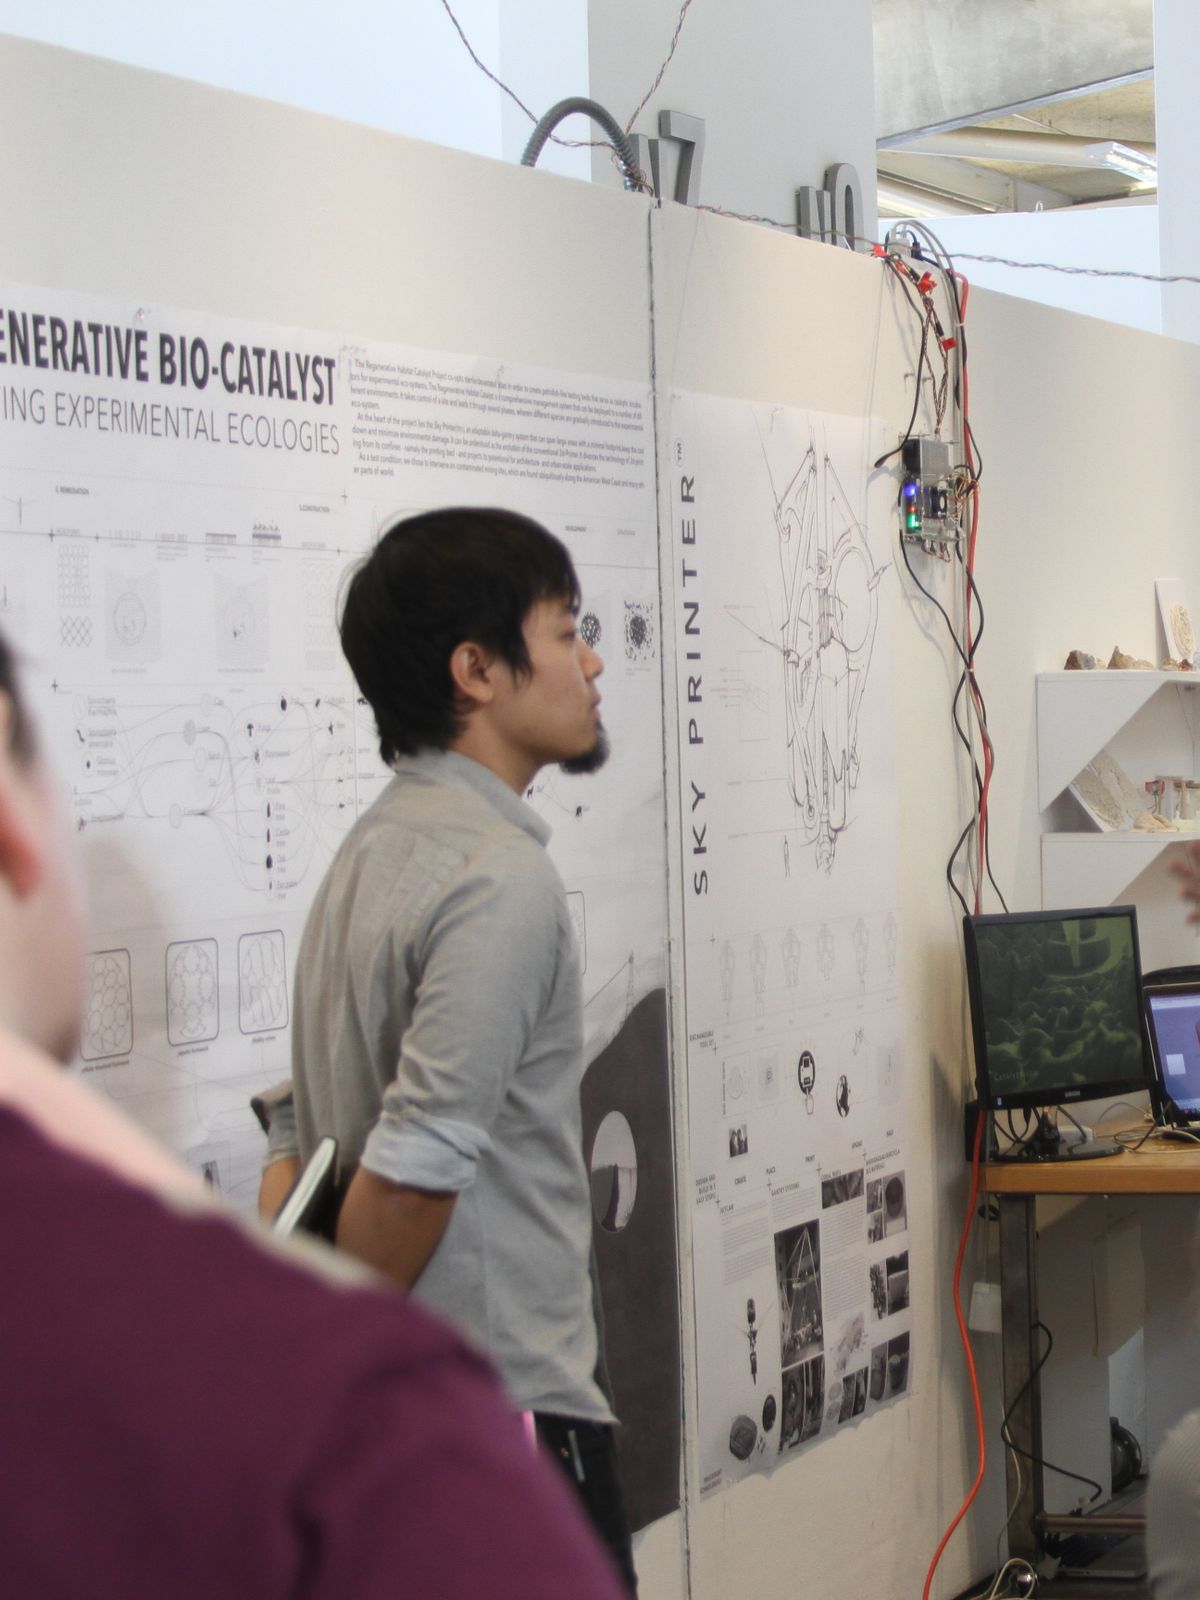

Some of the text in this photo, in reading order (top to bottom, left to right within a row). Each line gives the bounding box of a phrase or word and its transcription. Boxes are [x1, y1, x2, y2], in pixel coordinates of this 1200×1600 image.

[159, 332, 336, 406] BIO-CATALYST
[0, 385, 340, 455] ING EXPERIMENTAL ECOLOGIES
[680, 474, 709, 897] SKY PRINTER
